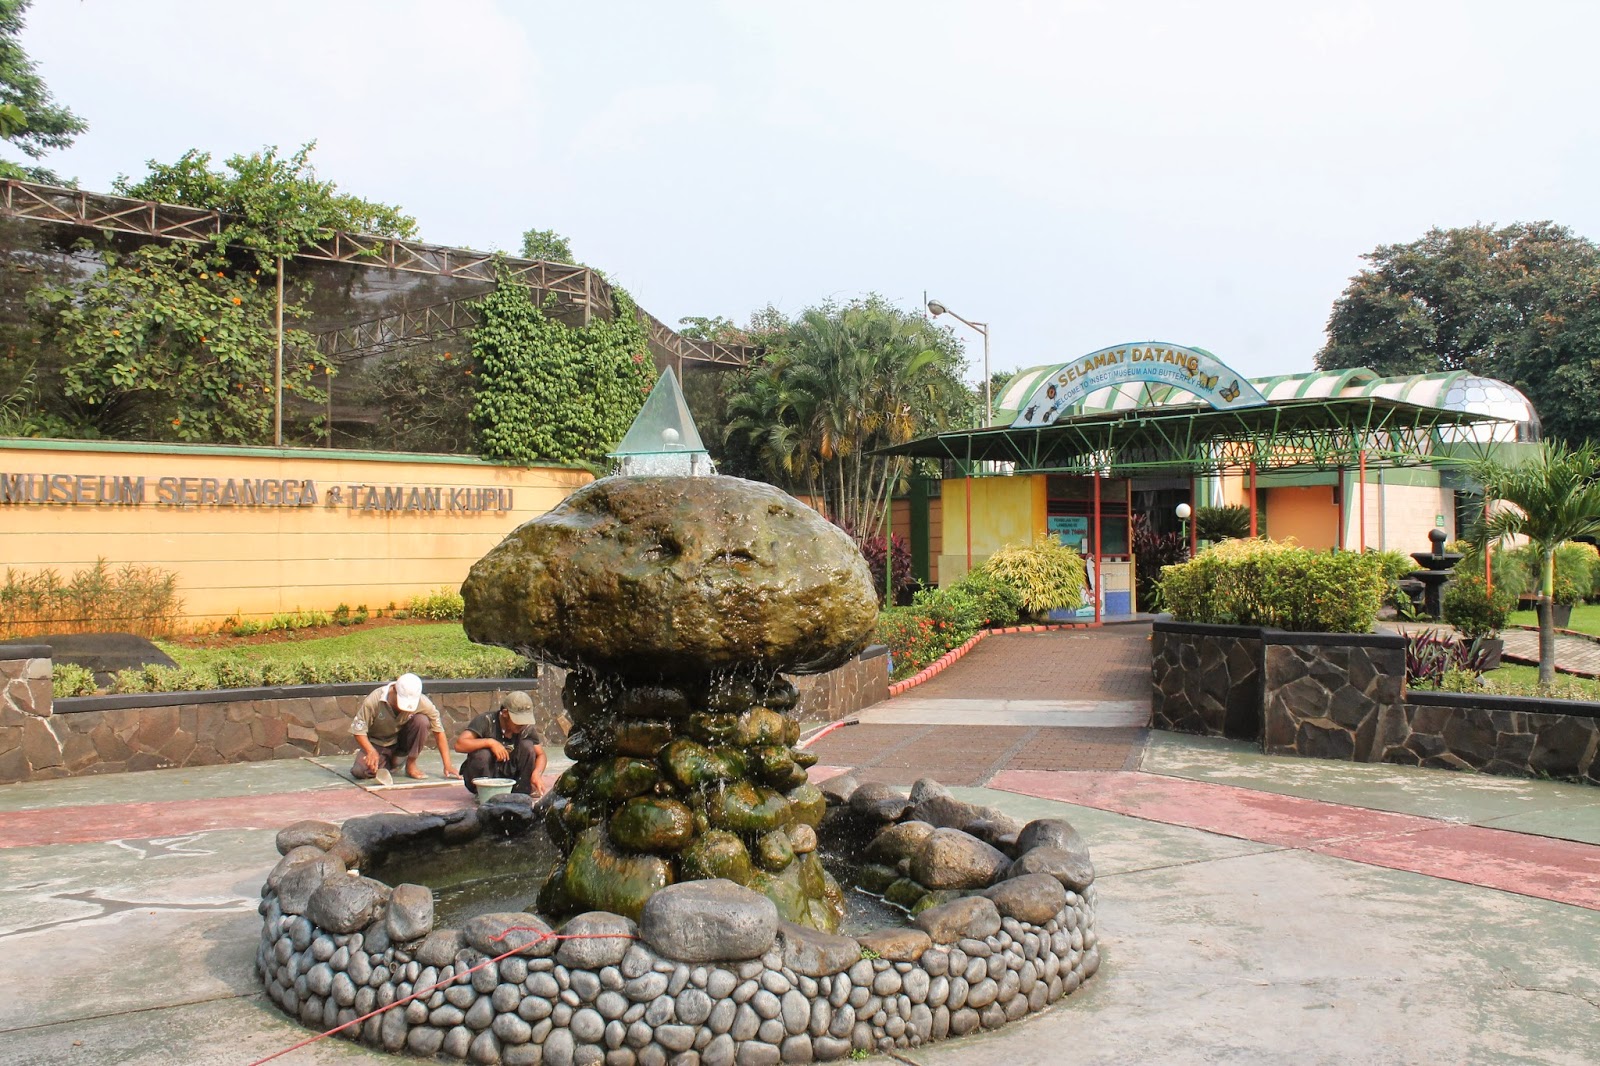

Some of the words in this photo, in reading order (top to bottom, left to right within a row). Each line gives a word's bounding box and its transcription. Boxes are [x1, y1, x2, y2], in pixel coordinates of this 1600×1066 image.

[1057, 350, 1126, 388] SELAMAT
[1131, 347, 1199, 371] DATANG
[1080, 380, 1089, 390] TO
[1089, 372, 1112, 385] INSECT
[1113, 368, 1142, 378] MUSEUM
[1142, 367, 1157, 375] AND
[1158, 368, 1196, 385] BUTTERFLY
[0, 473, 145, 504] MUSEUM
[159, 476, 319, 506] SERANGGA
[331, 485, 344, 504] &
[347, 485, 442, 511] TAMAN
[449, 487, 513, 512] KUPU
